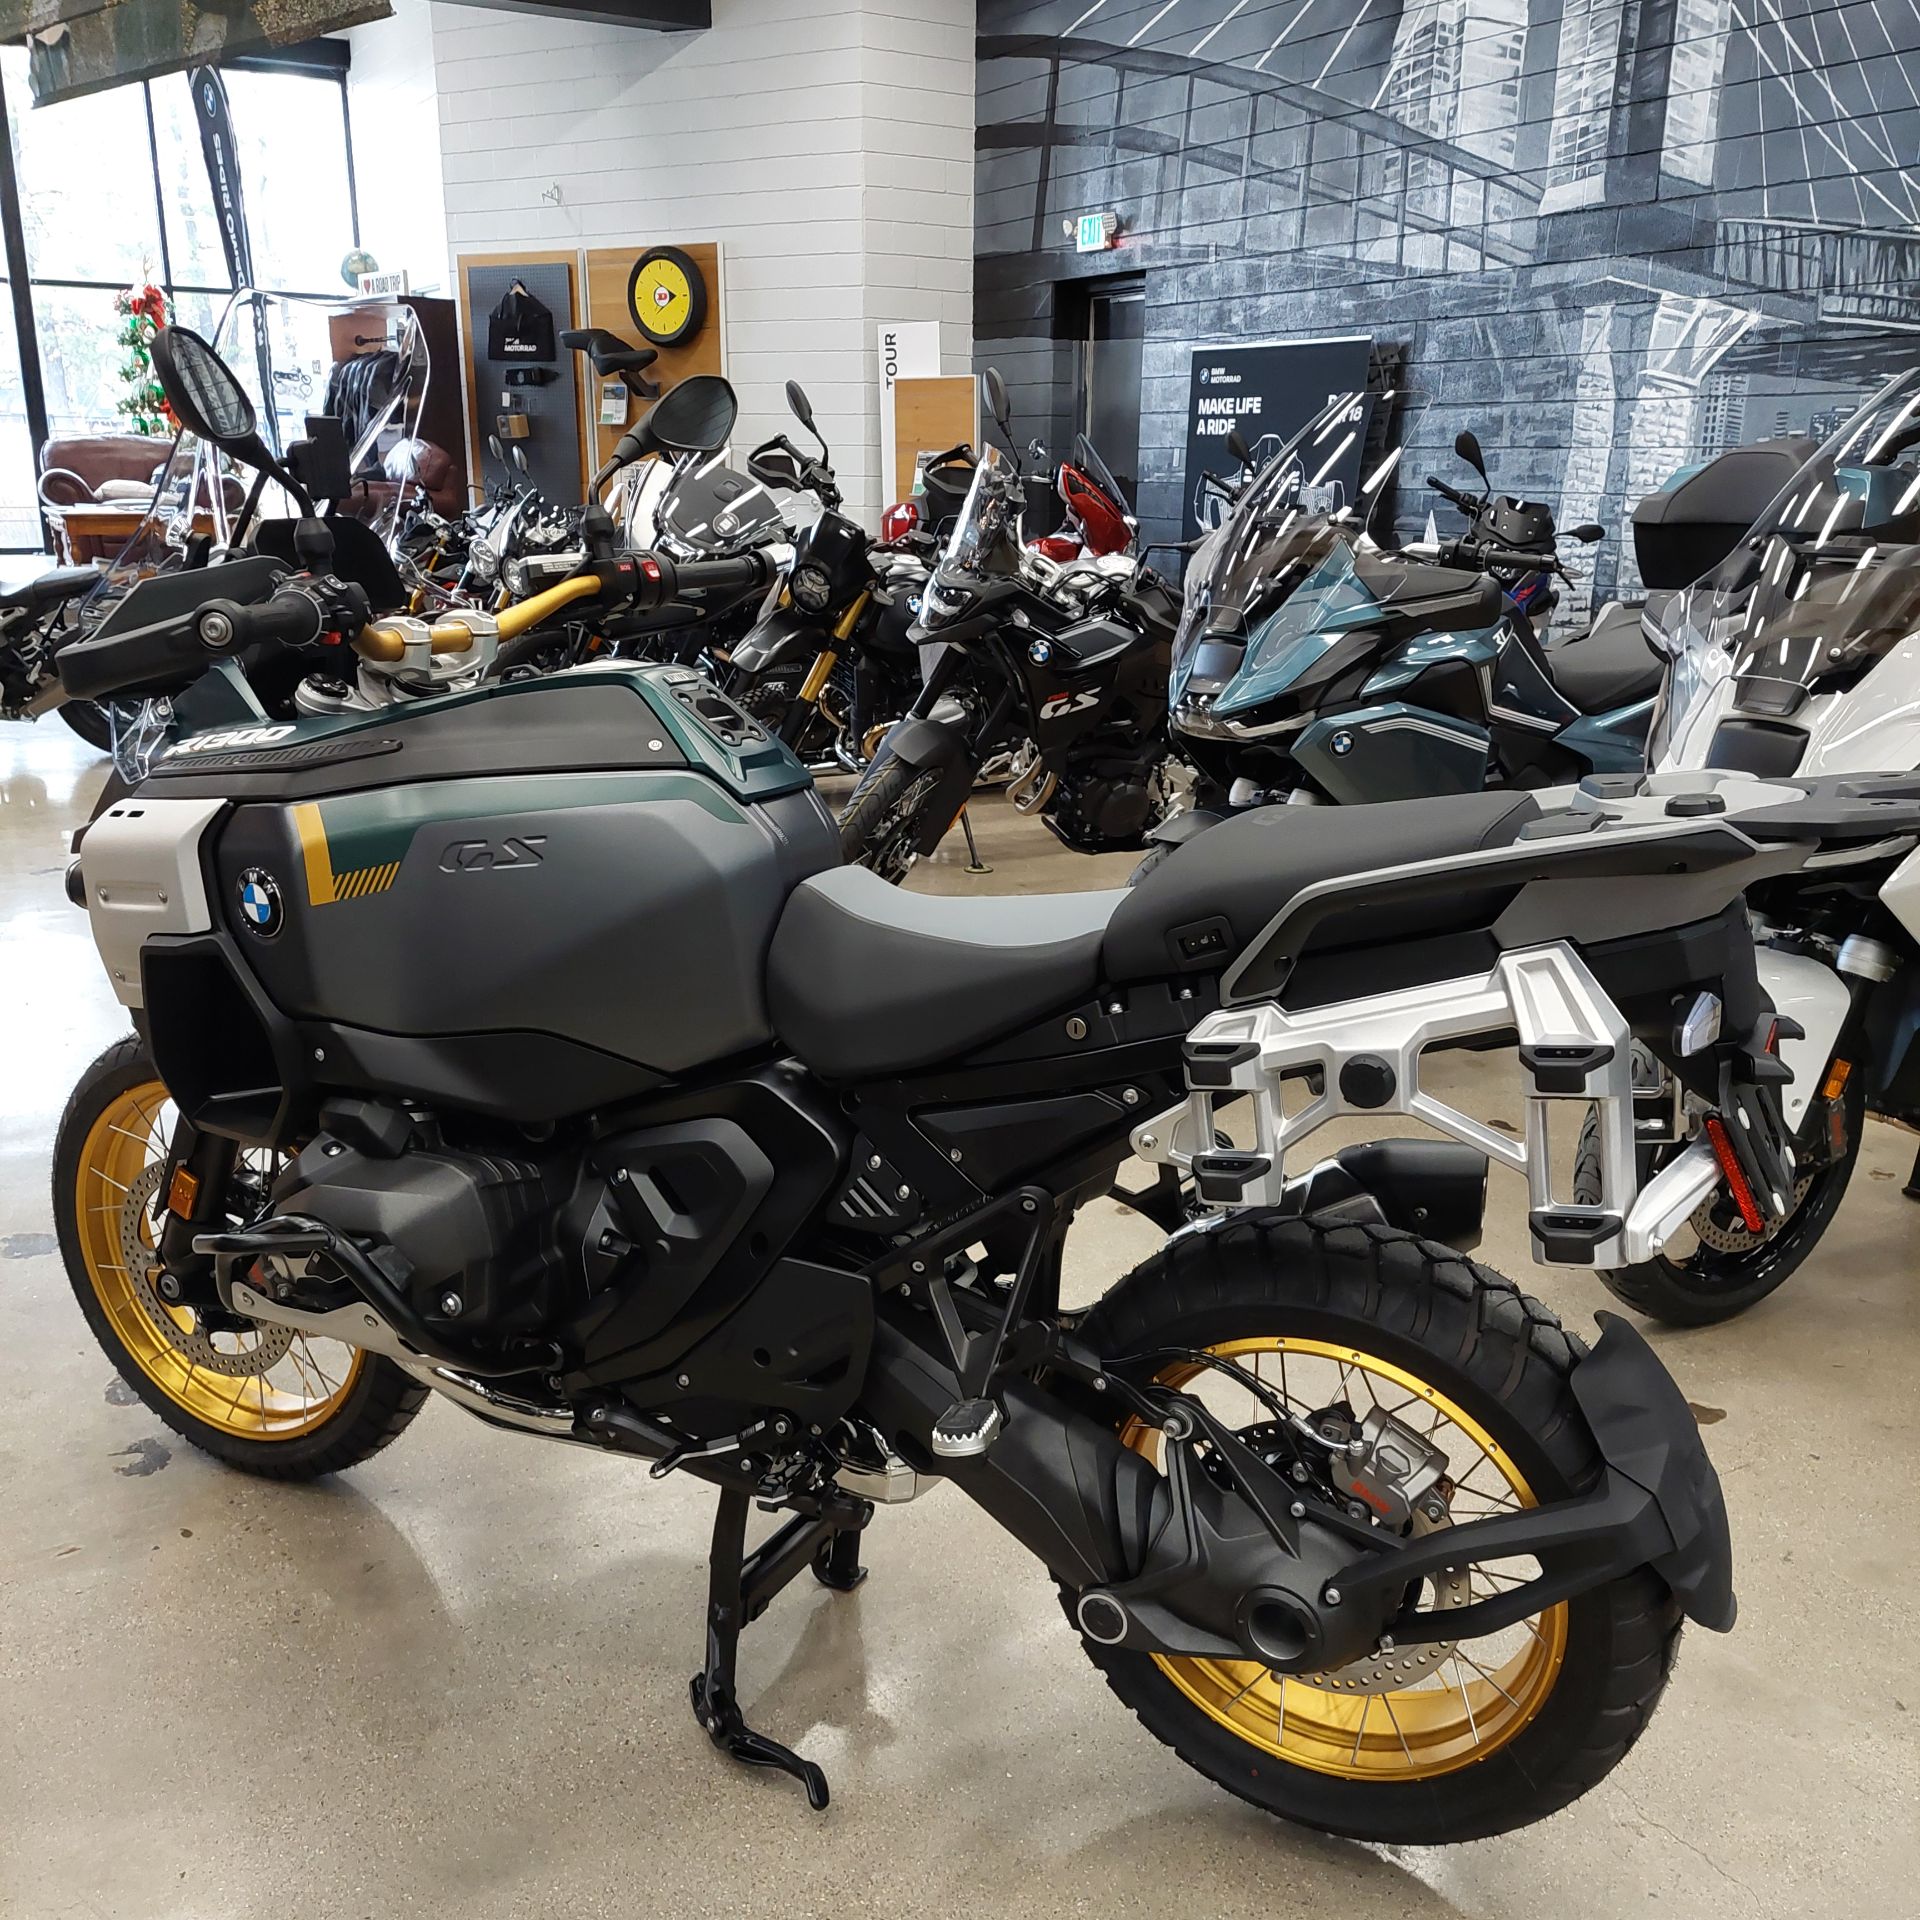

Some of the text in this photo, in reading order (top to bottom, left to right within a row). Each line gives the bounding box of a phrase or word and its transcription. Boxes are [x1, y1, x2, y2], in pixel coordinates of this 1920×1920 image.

[212, 132, 232, 210] RIDES
[1081, 215, 1105, 246] EXIT
[375, 276, 390, 294] ROAD
[389, 274, 402, 292] TRIP
[504, 344, 538, 352] MOTORRAD
[885, 332, 898, 390] TOUR
[1210, 367, 1226, 376] BMW
[1210, 375, 1242, 384] MOTORRAD
[1197, 396, 1262, 415] MAKE LIFE
[1196, 418, 1236, 435] A RIDE
[1039, 686, 1102, 720] GS
[438, 834, 548, 874] GS
